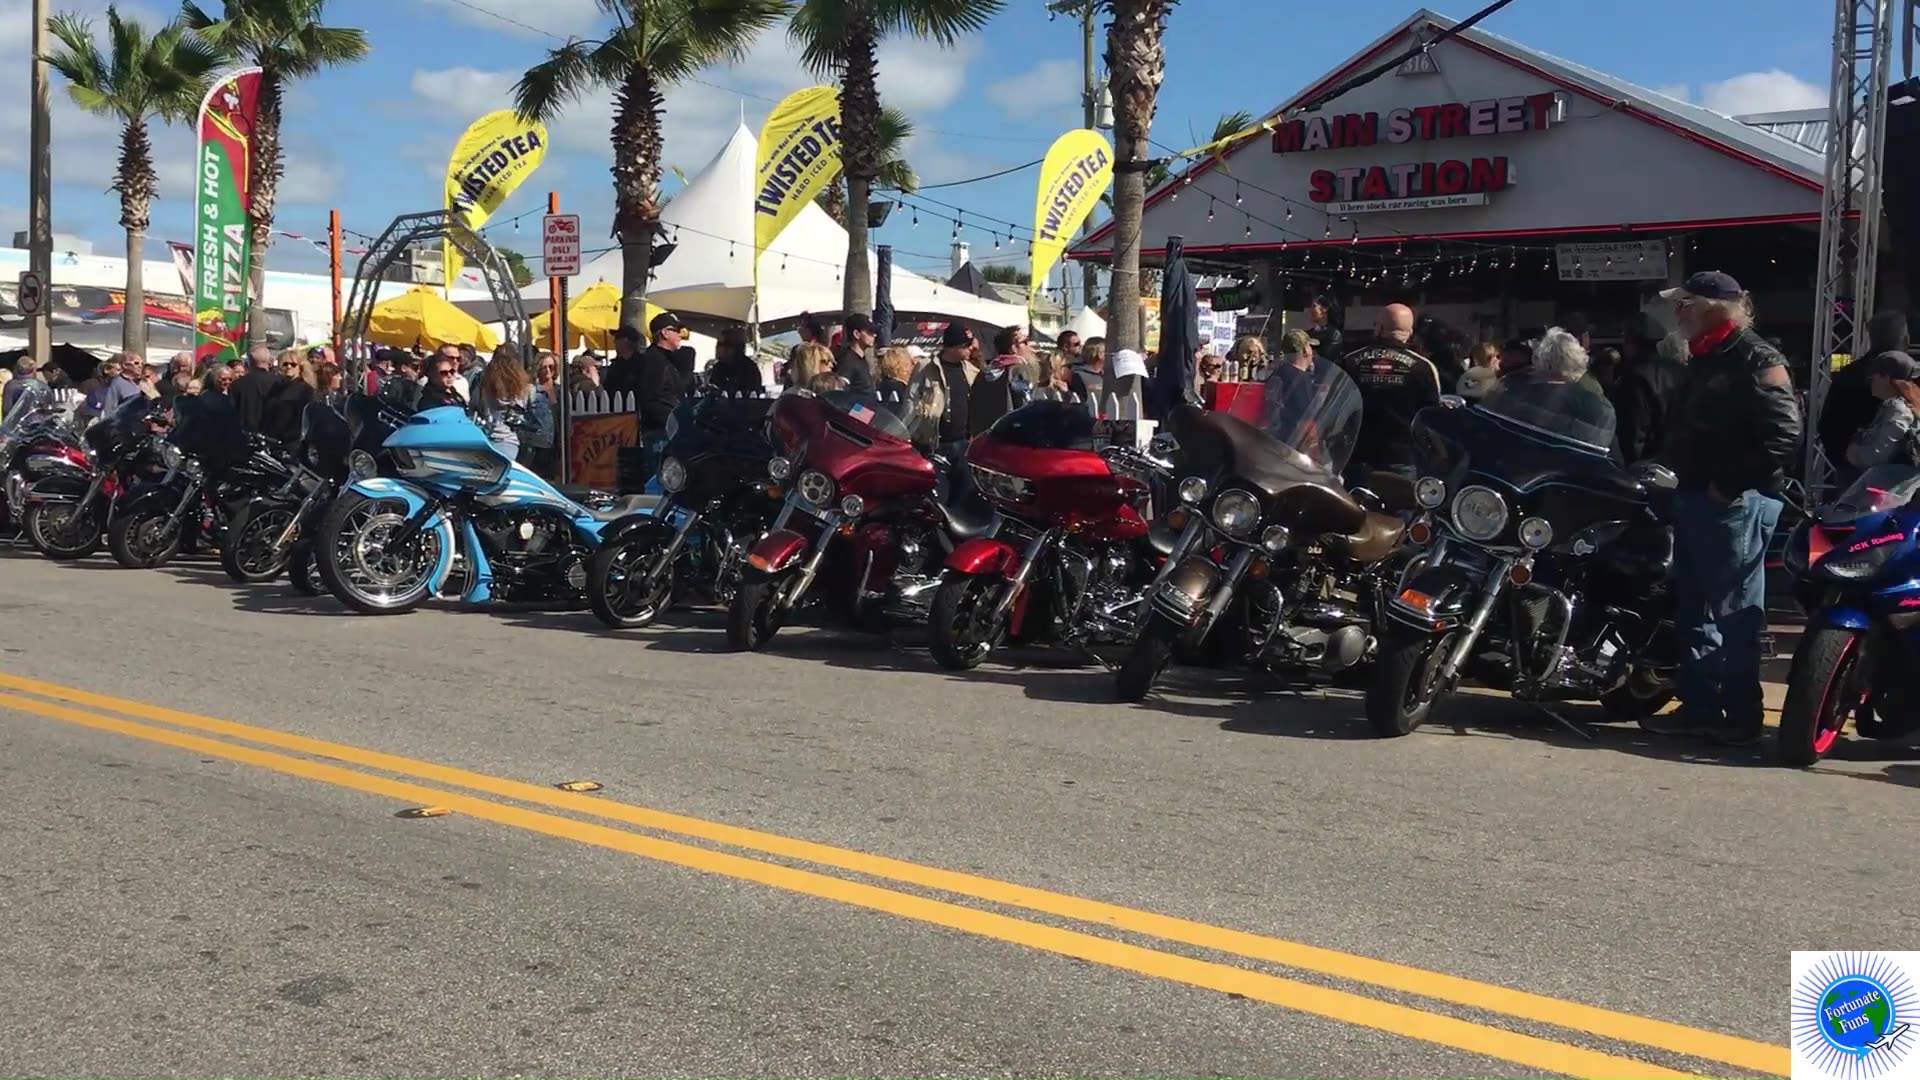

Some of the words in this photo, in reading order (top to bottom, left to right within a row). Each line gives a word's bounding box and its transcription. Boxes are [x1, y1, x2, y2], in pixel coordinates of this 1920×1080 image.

[1272, 112, 1378, 153] MAIN
[1386, 92, 1555, 144] STREET
[500, 130, 542, 160] TEA
[755, 135, 822, 217] TWISTED
[811, 115, 841, 147] TE
[204, 146, 221, 198] HOT
[497, 171, 512, 185] ICED
[513, 160, 527, 171] TEA
[792, 178, 810, 201] HARD
[810, 160, 828, 178] ICED
[1309, 157, 1508, 203] STATION
[204, 203, 219, 220] &
[1040, 171, 1085, 241] TWISTED
[1076, 147, 1109, 179] TEA
[1366, 200, 1387, 209] stock
[1403, 198, 1429, 208] racing
[1431, 198, 1446, 206] was
[1447, 196, 1468, 205] born
[545, 235, 578, 243] PARKING
[552, 246, 570, 254] ONLY
[203, 225, 218, 300] FRESH
[223, 223, 245, 313] PIZZA
